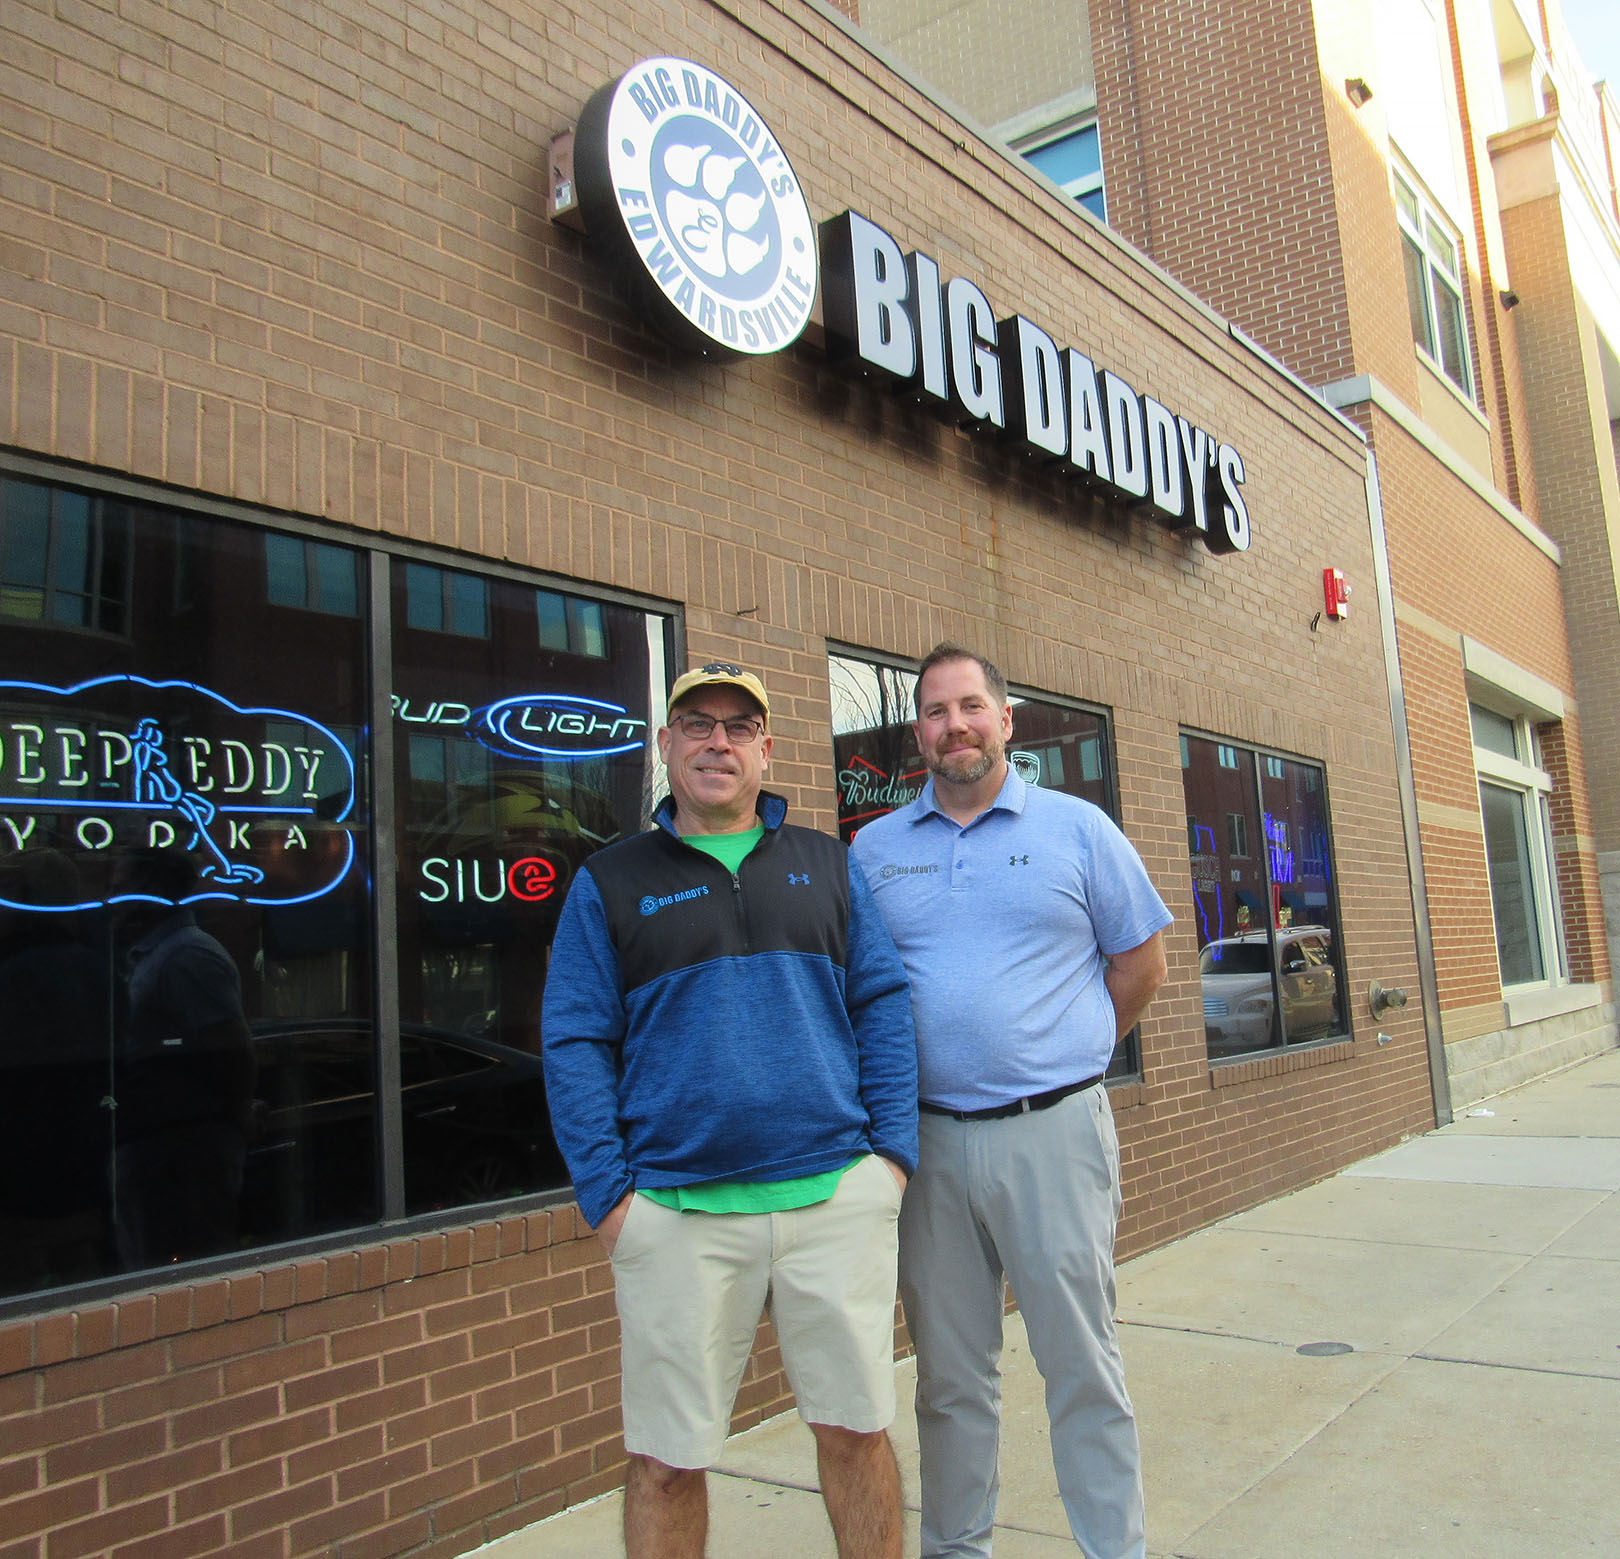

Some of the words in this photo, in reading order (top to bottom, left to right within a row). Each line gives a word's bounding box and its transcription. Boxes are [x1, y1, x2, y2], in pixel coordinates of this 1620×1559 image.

[628, 67, 681, 125] BIG
[681, 67, 795, 199] DADDY'S
[618, 187, 812, 348] EDWARDSVILLE
[848, 210, 1006, 429] BIG
[1017, 314, 1251, 552] DADDY'S
[520, 706, 647, 739] LIGHT
[0, 724, 133, 788] EEP
[183, 737, 325, 799] EDDY
[839, 769, 922, 805] Budwei
[4, 816, 308, 850] VODKA
[897, 866, 909, 875] BIG
[658, 895, 674, 906] BIG
[674, 885, 710, 902] DADDY'S
